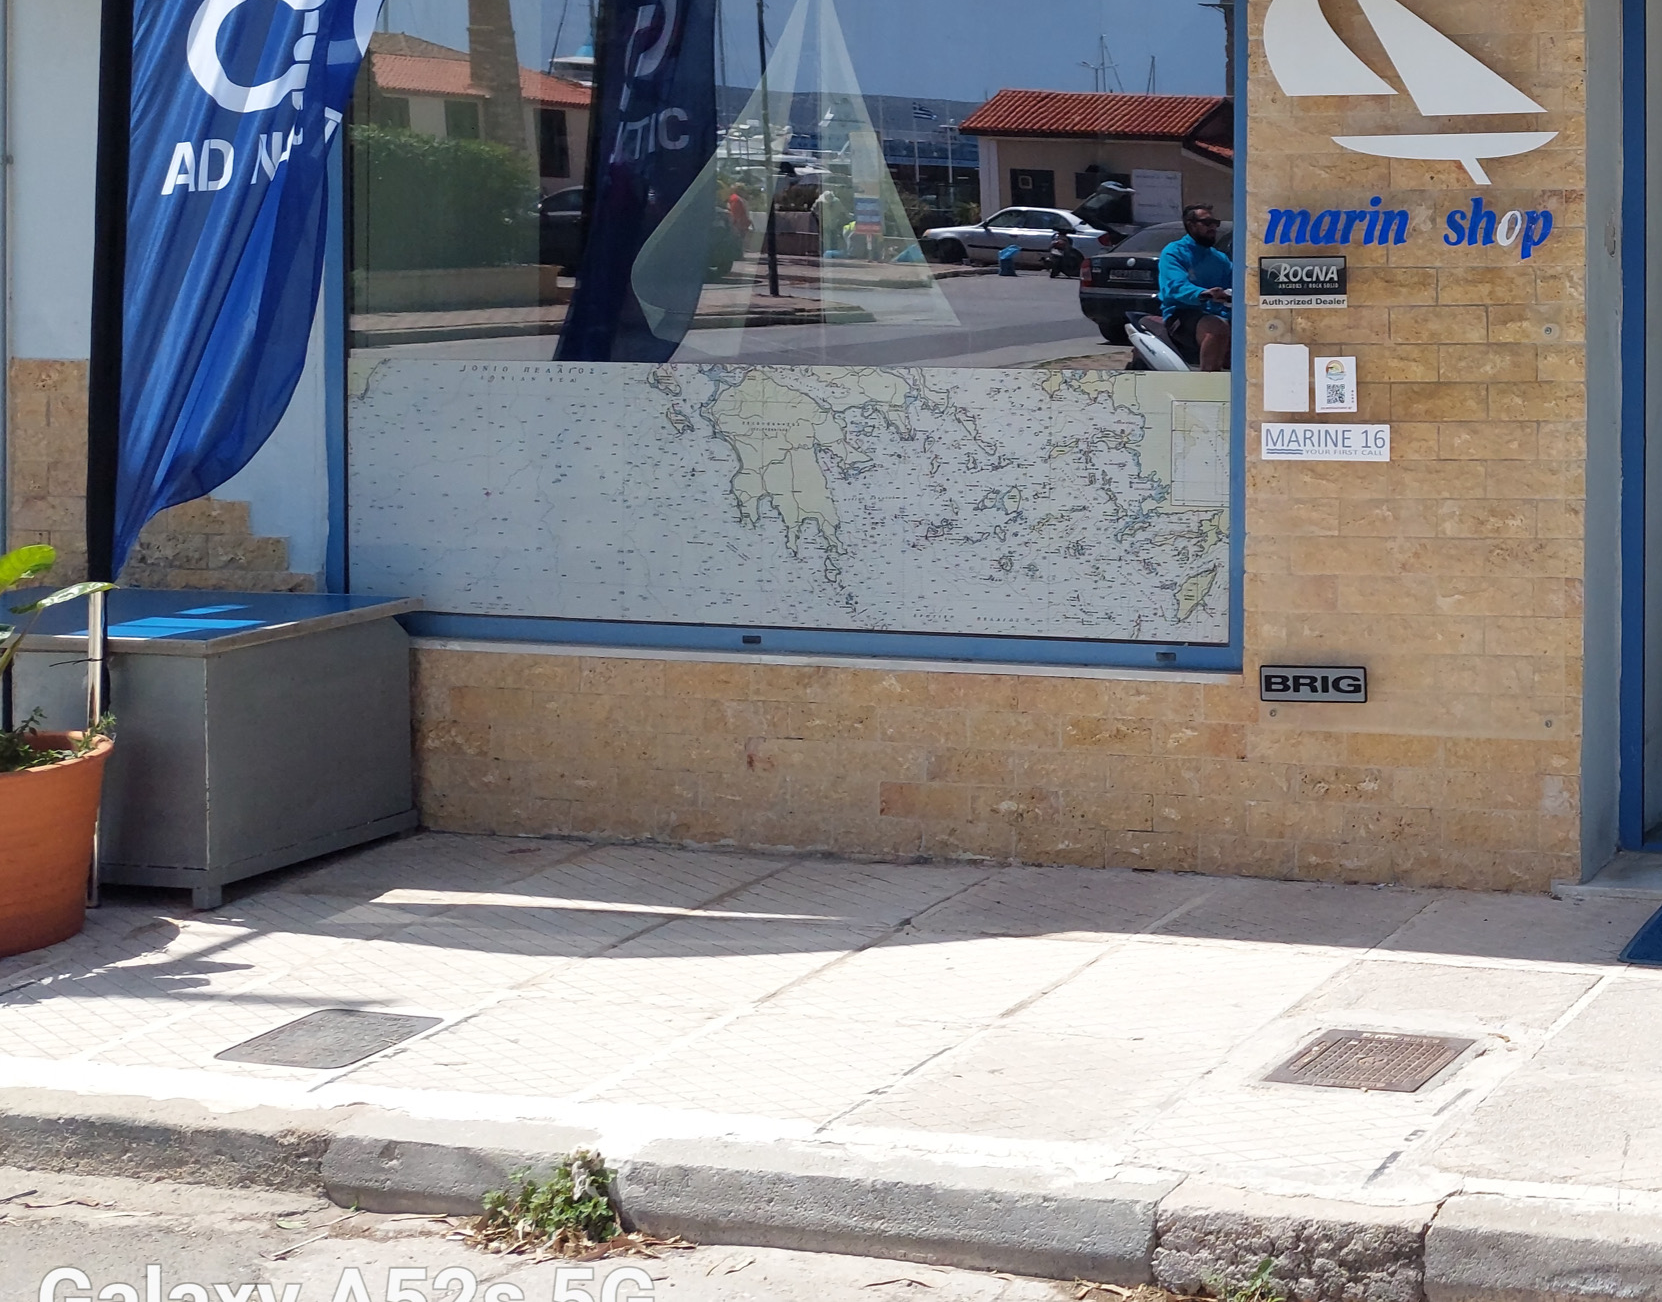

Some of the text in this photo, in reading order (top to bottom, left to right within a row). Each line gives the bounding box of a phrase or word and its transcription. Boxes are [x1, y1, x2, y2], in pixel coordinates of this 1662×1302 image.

[161, 138, 235, 196] AD
[1265, 196, 1554, 260] marin shop
[1270, 263, 1339, 282] ROCNA
[1261, 297, 1346, 306] Authorized Dealer
[1265, 428, 1386, 449] MARINE 16
[1264, 675, 1362, 694] BRIG
